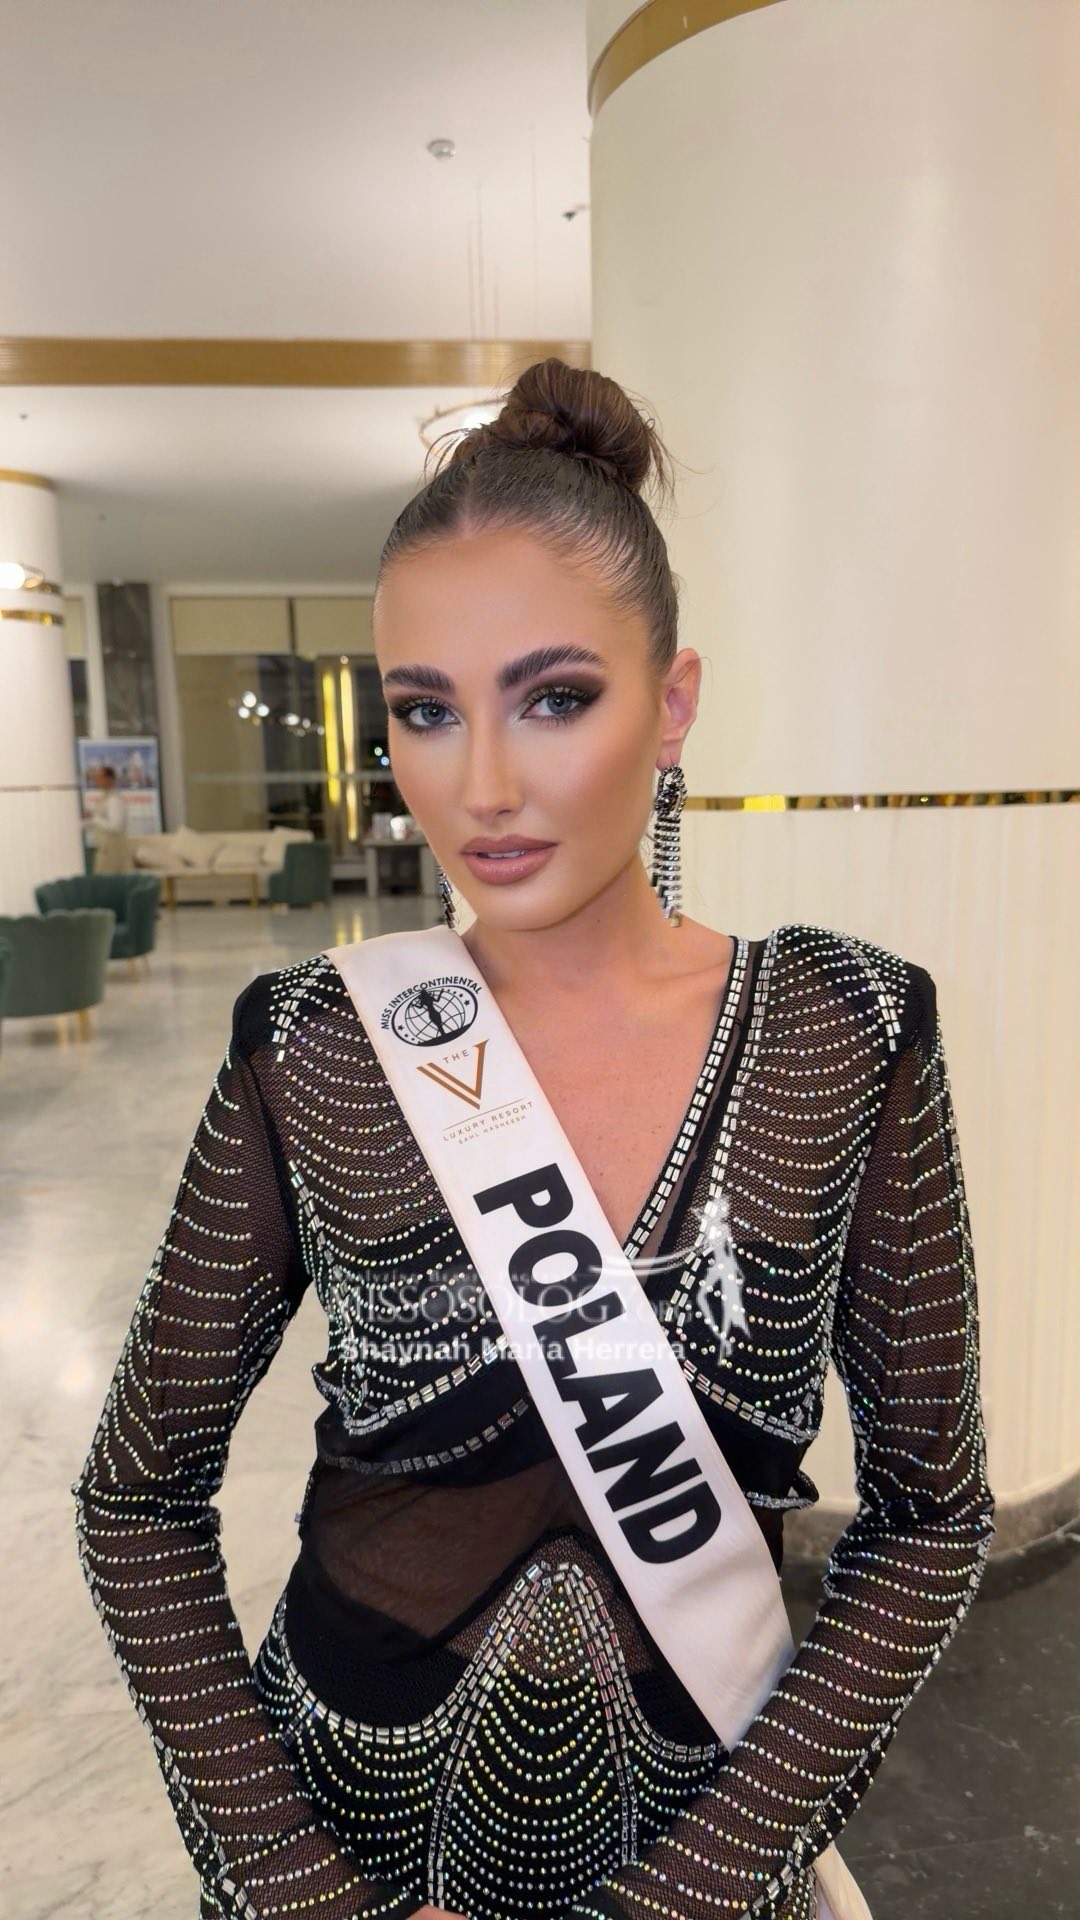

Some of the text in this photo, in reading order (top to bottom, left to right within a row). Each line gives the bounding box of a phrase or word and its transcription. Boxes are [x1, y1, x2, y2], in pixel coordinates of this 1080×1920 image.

[381, 976, 482, 1030] MISS INTERCONTINENTAL
[443, 1049, 470, 1064] THE
[443, 1101, 533, 1142] LUXURY RESORT
[458, 1132, 480, 1145] SAHL
[473, 1162, 722, 1565] POLAND
